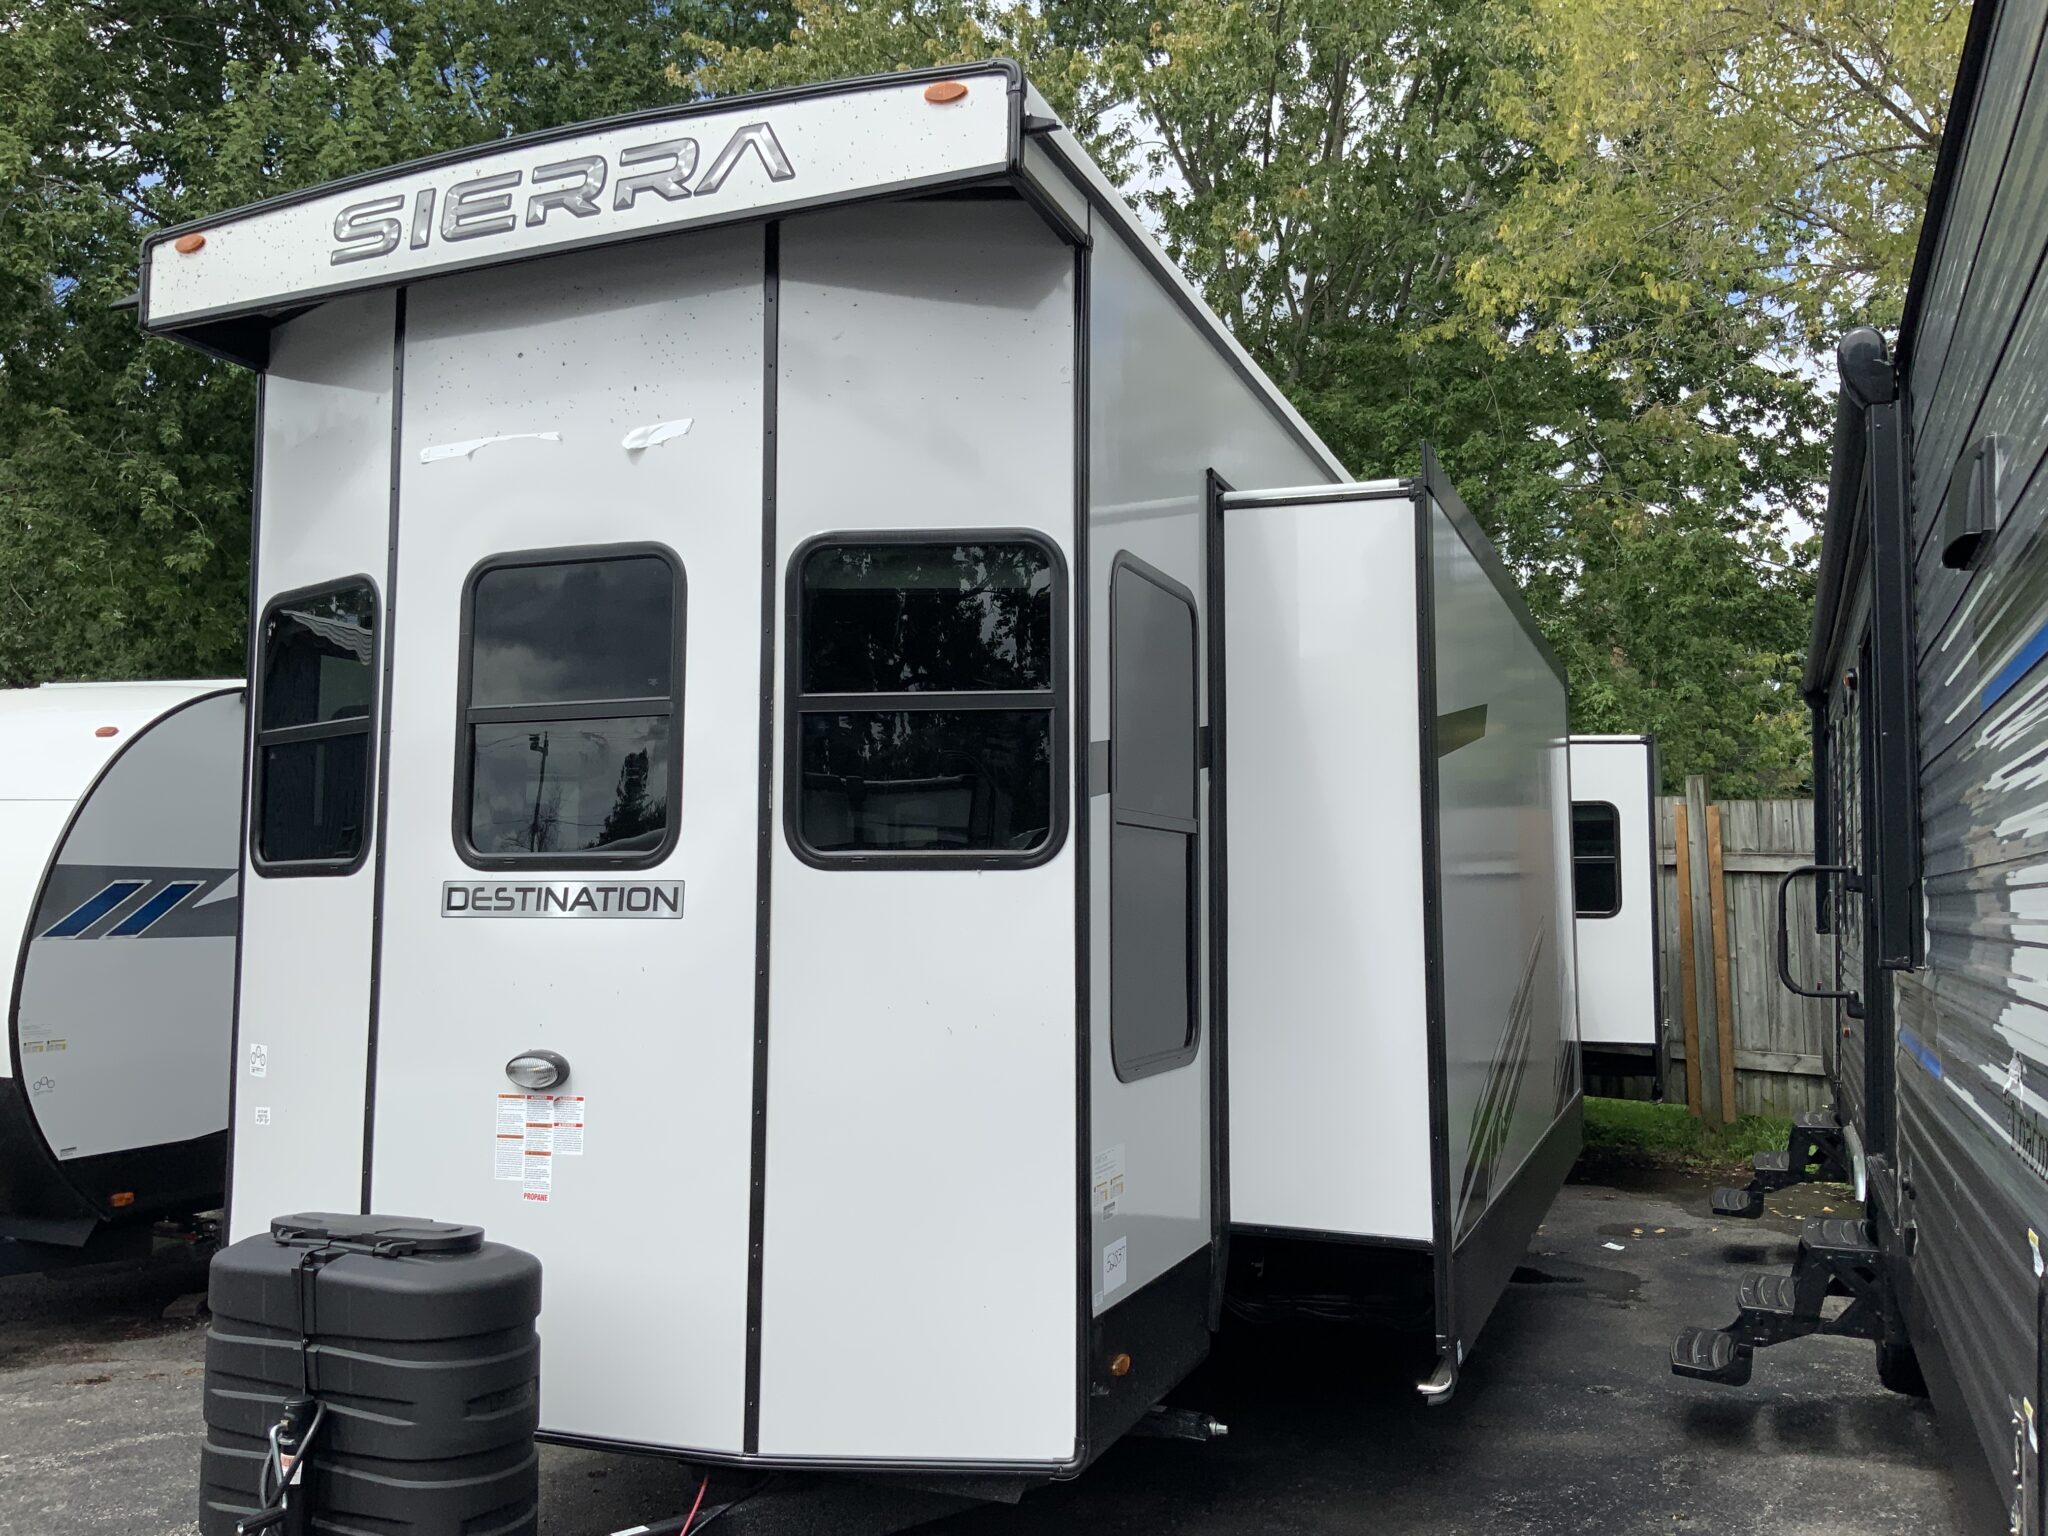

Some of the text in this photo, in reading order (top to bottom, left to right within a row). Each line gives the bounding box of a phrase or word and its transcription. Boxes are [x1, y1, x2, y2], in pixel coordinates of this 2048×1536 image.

[330, 121, 796, 266] SIERRA
[446, 886, 679, 912] DESTINATION
[523, 1192, 548, 1202] PROPANE
